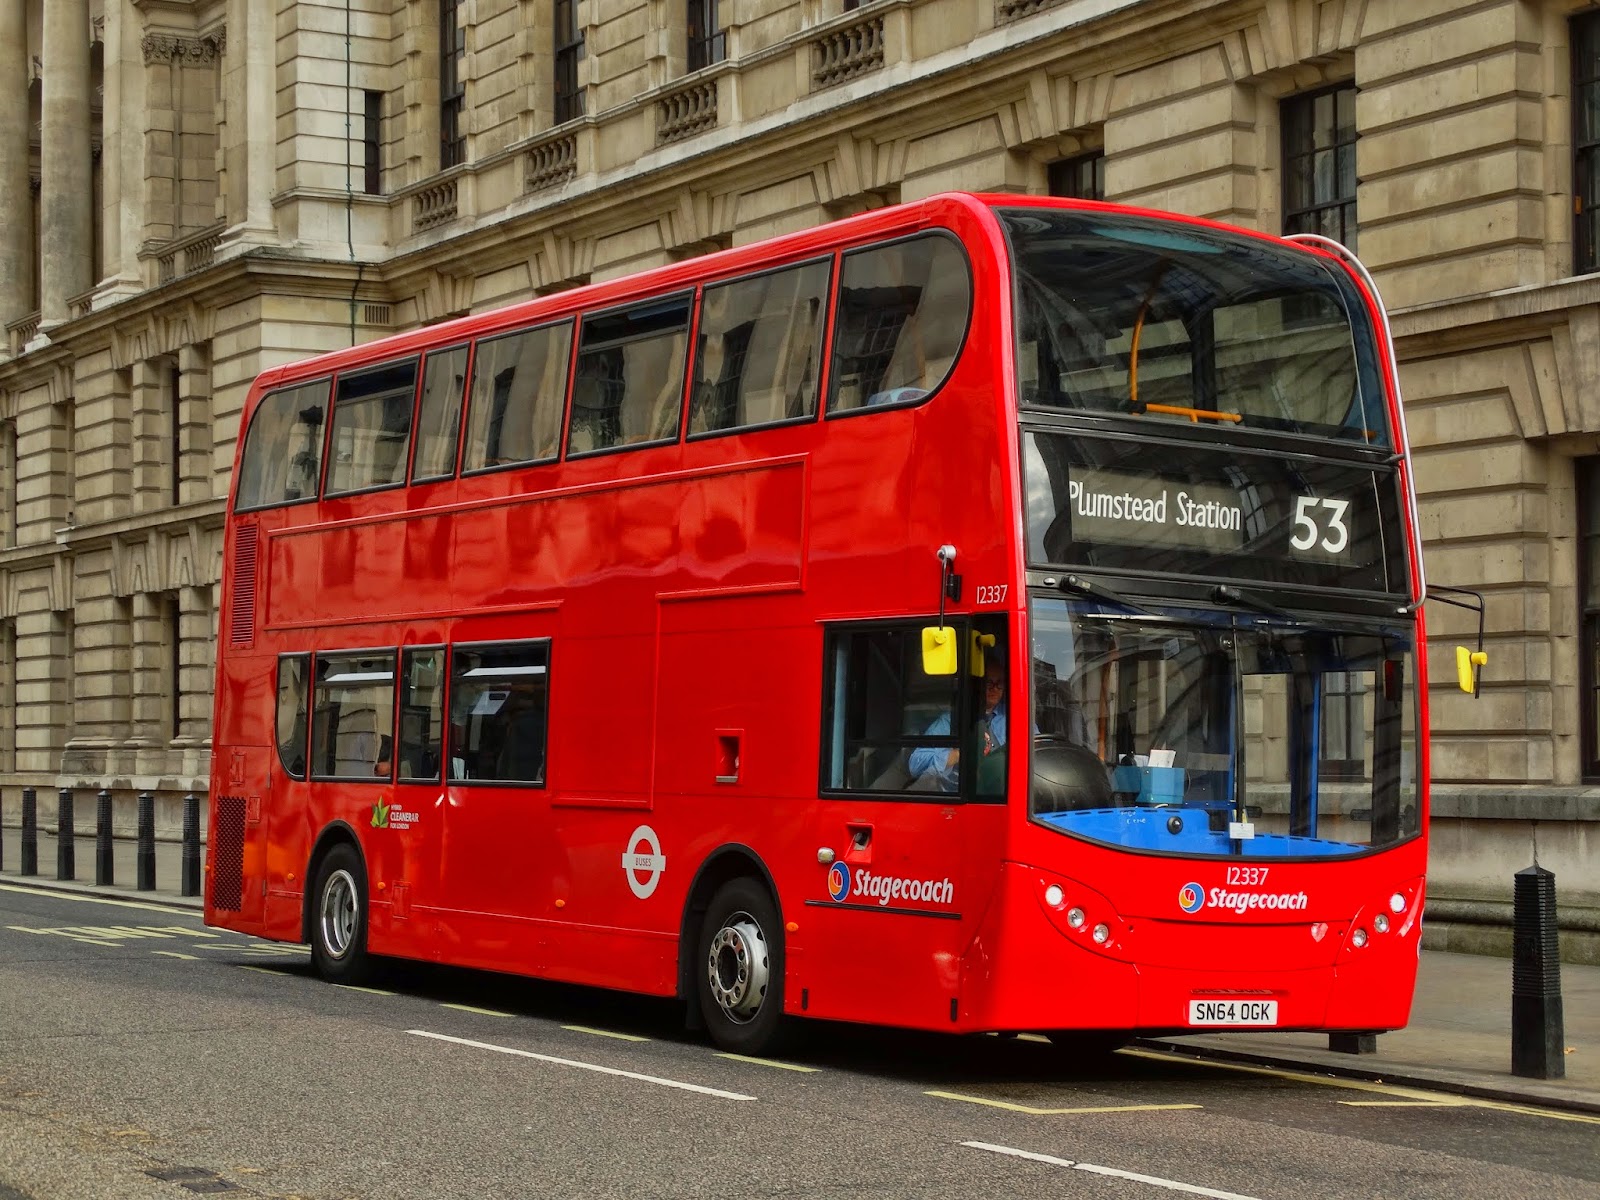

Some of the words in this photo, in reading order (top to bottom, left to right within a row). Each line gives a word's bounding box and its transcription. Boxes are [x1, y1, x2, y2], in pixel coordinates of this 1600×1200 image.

[1069, 480, 1168, 524] Plumstead
[1175, 491, 1242, 531] Station
[1290, 496, 1350, 554] 53
[976, 584, 1008, 605] 12337
[635, 856, 652, 867] BUSES
[853, 868, 954, 906] Stagecoach
[1226, 866, 1269, 886] 12337
[1207, 887, 1308, 914] Stagecoach
[1196, 1003, 1236, 1020] SN64
[1241, 1003, 1270, 1020] OGK
